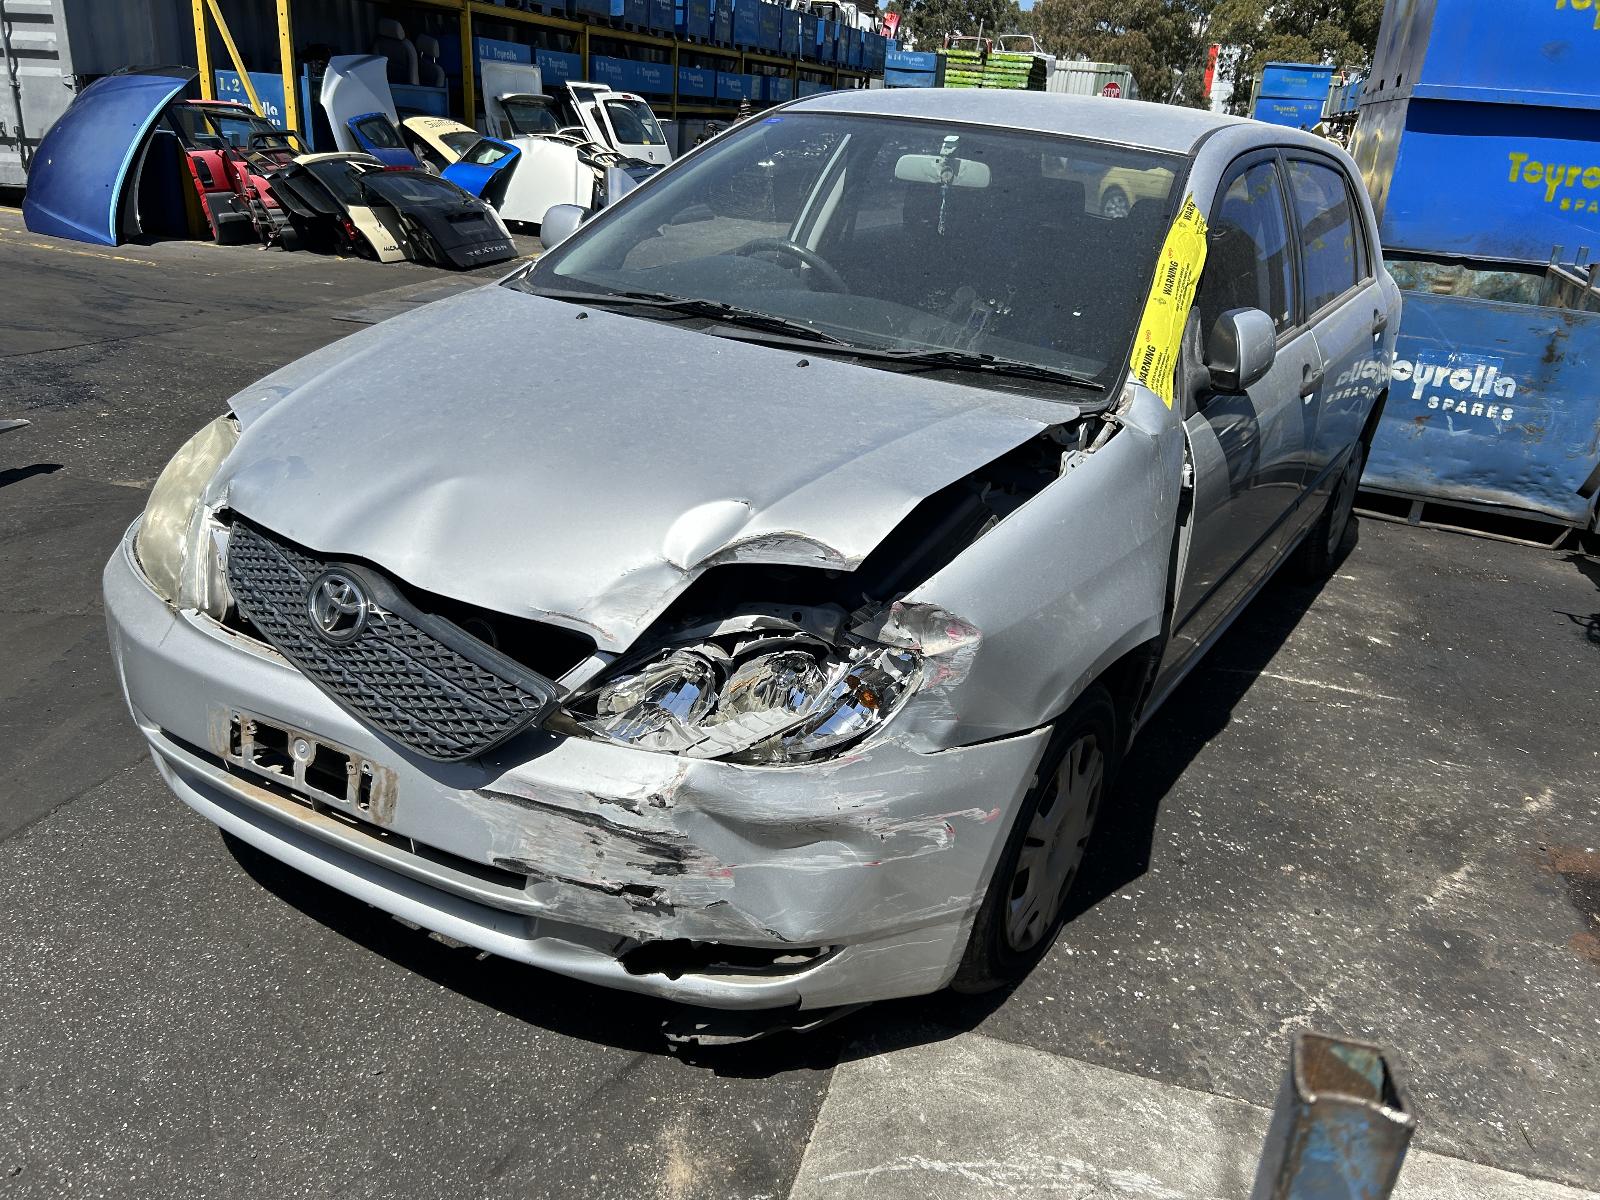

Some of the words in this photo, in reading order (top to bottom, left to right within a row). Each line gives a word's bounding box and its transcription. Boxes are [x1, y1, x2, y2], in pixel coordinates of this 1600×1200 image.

[1103, 87, 1120, 98] STOP
[1163, 260, 1179, 296] WARNING
[1392, 352, 1517, 401] oyrolla
[1427, 396, 1514, 421] SPARES
